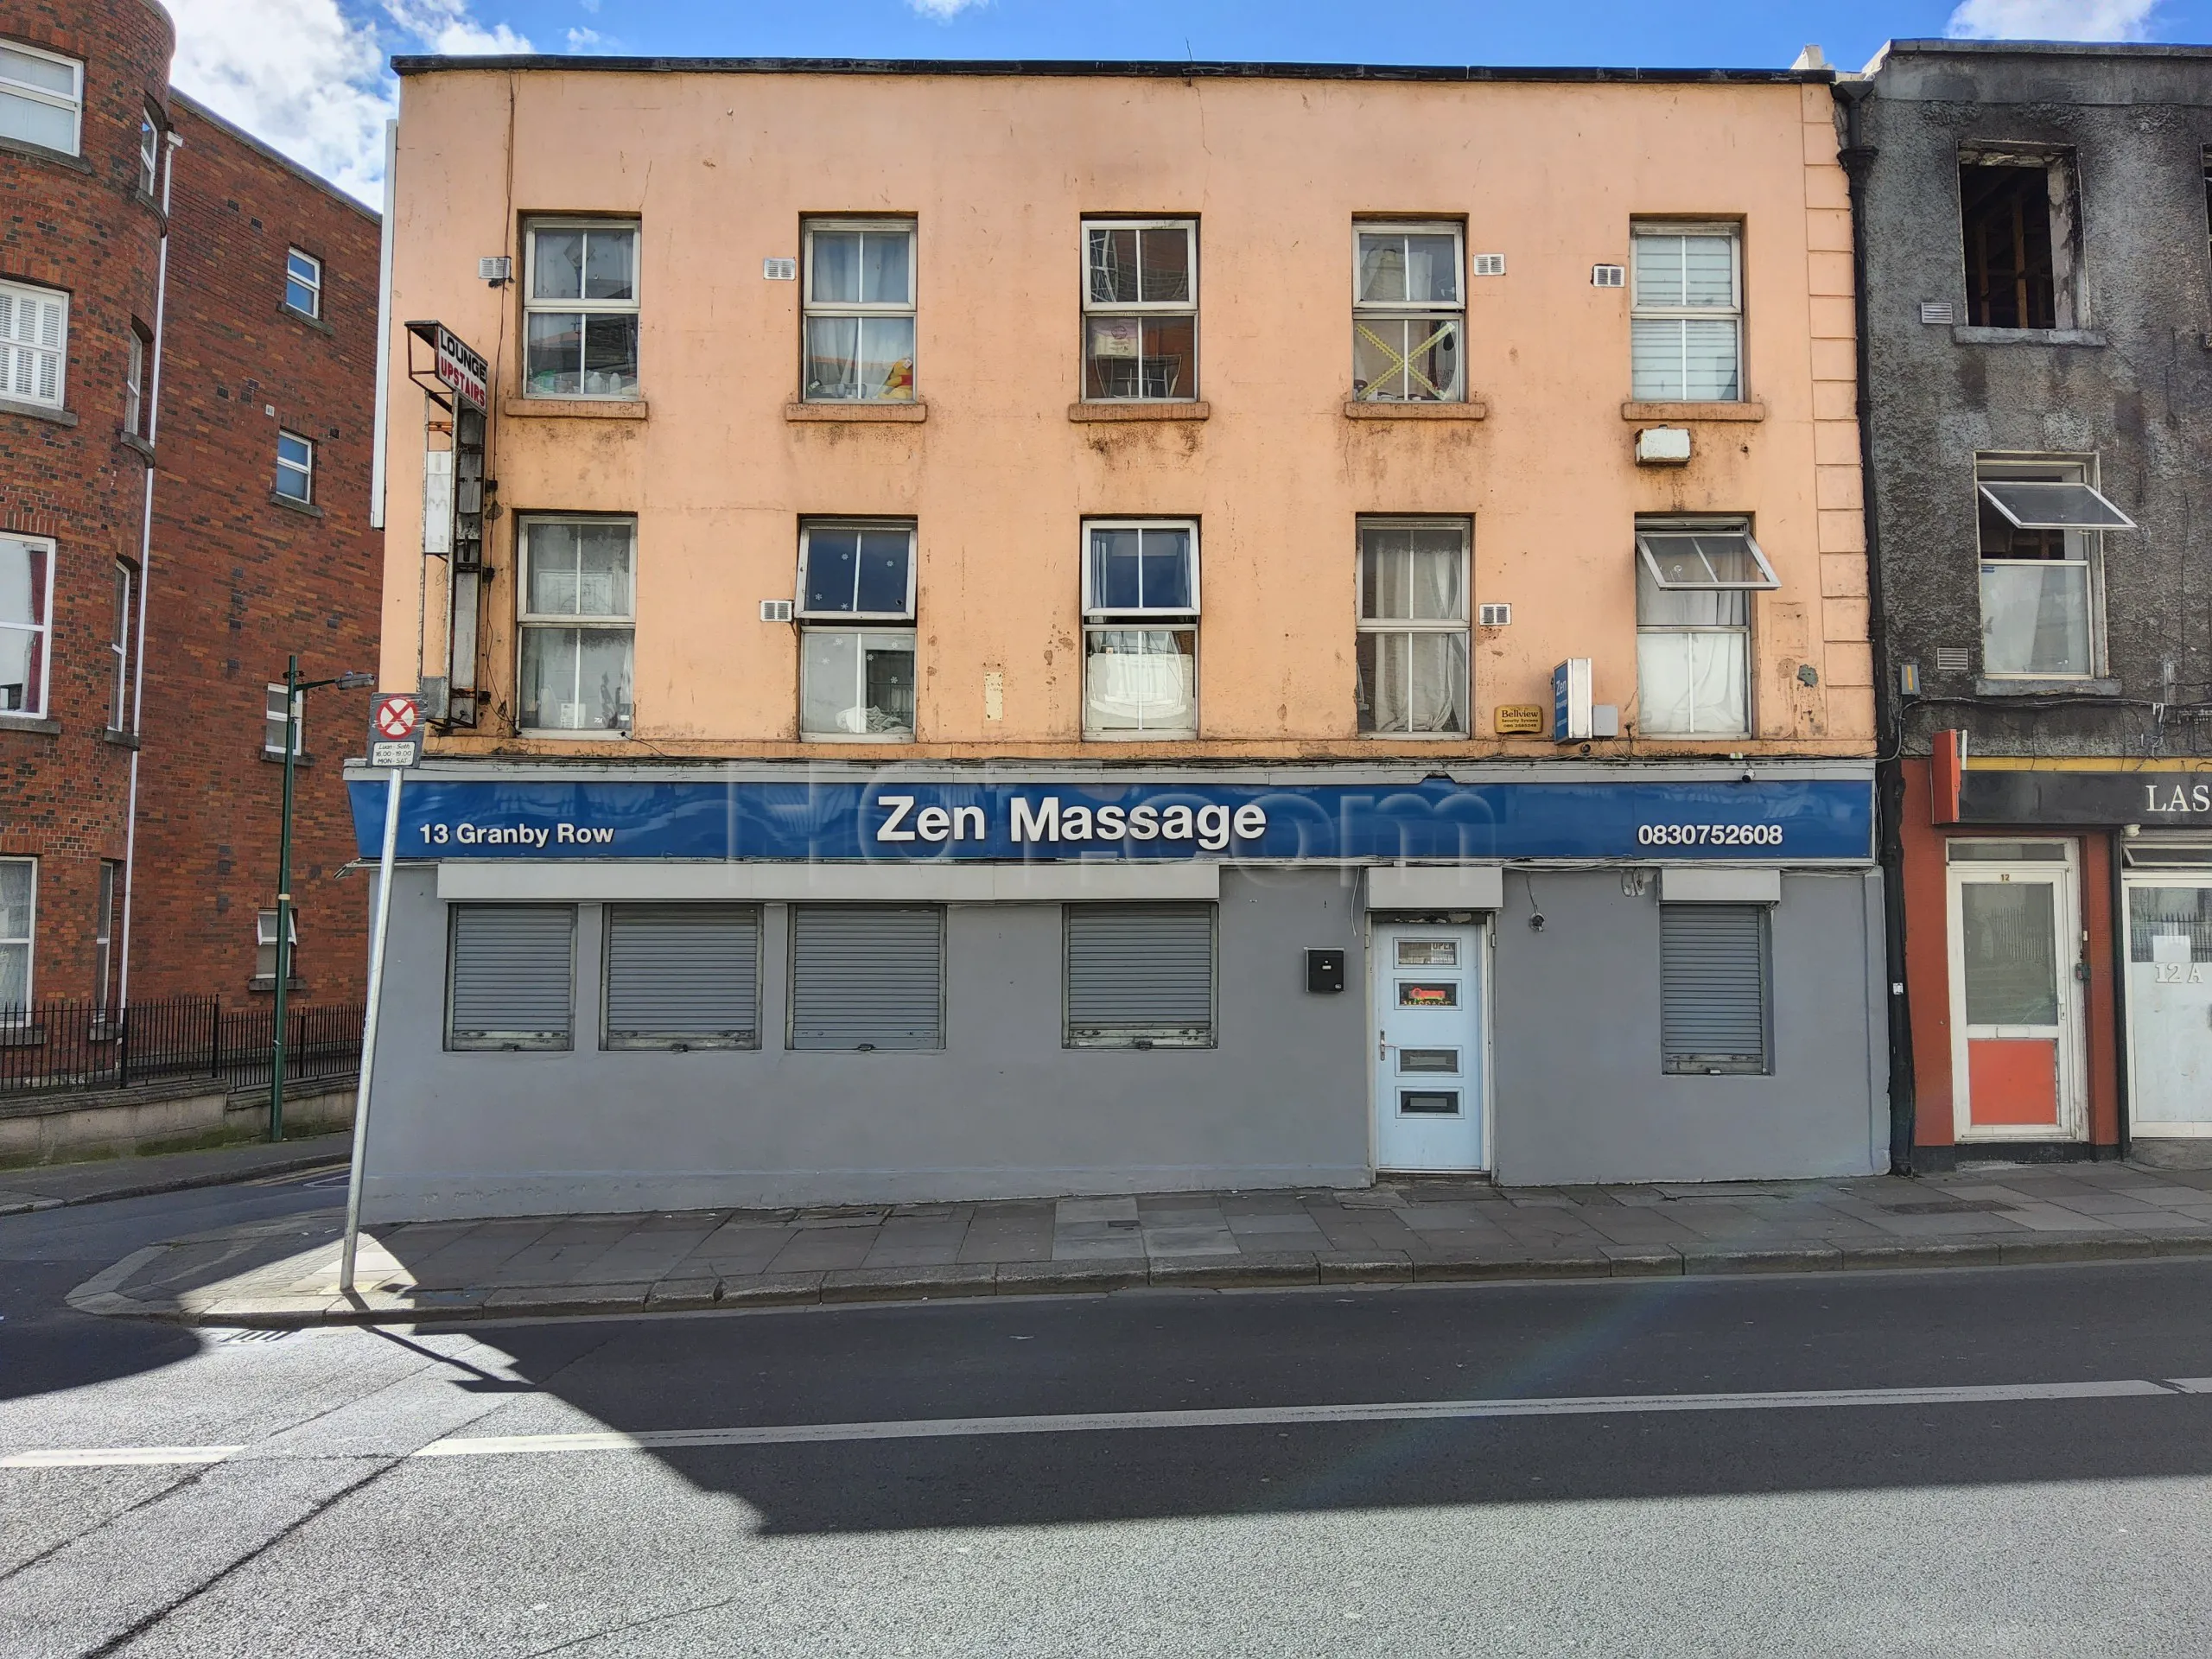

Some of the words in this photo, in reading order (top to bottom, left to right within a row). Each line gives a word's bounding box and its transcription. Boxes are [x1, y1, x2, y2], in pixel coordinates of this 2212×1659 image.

[440, 329, 486, 385] LOUNGE
[441, 355, 486, 407] UPSTAIRS
[1556, 679, 1567, 696] Zen
[1502, 709, 1539, 718] Bellview
[876, 796, 985, 842] Zen
[1011, 796, 1267, 850] Massage
[420, 823, 449, 844] 13
[456, 823, 550, 847] Granby
[558, 823, 614, 844] Row
[1638, 824, 1783, 845] 0830752608
[2155, 963, 2183, 984] 12
